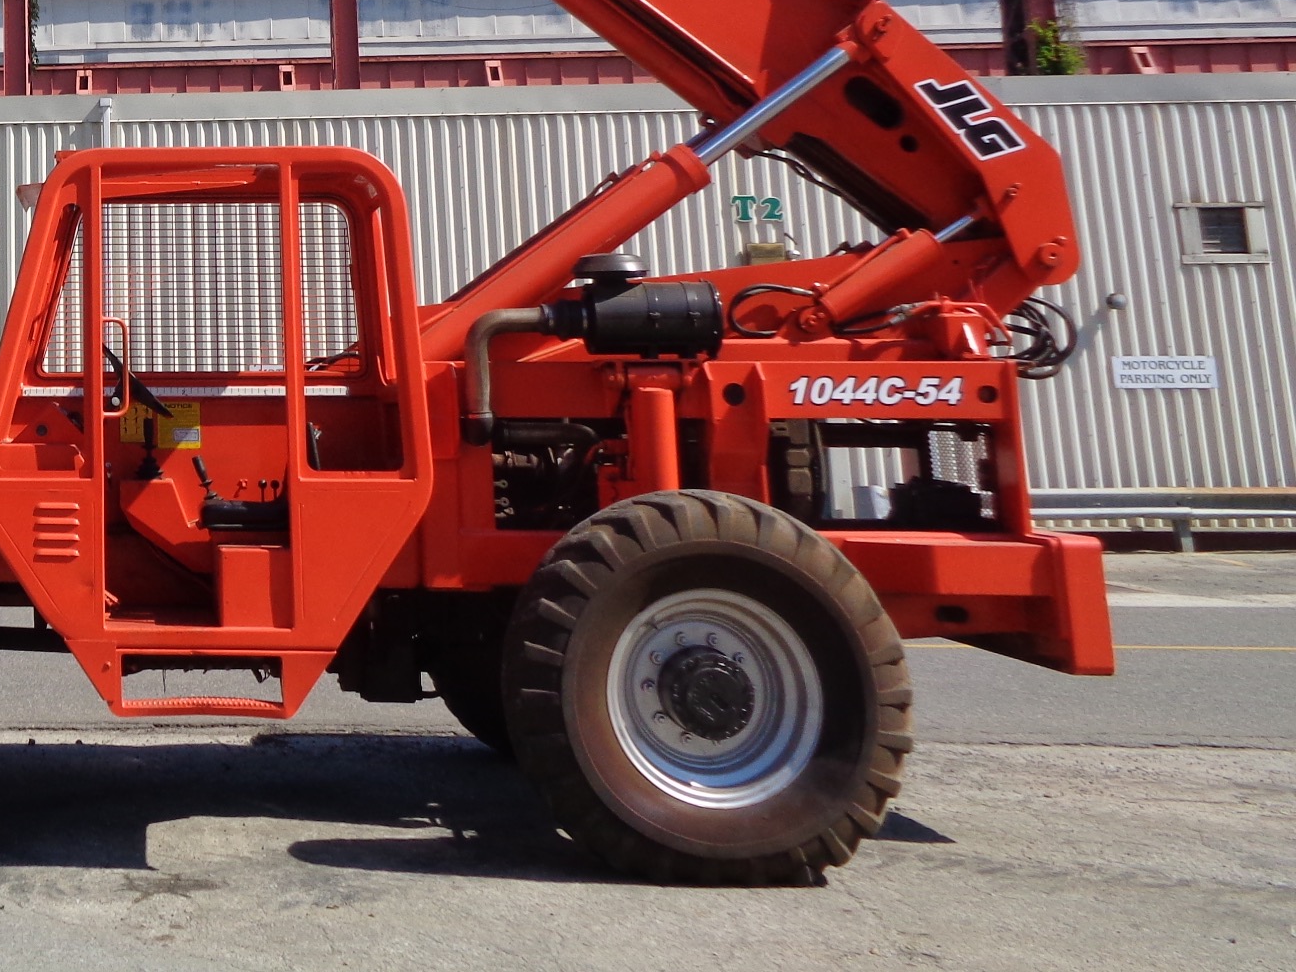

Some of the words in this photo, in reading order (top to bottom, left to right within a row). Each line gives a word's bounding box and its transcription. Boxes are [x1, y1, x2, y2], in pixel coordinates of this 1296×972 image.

[913, 78, 1026, 161] JLG
[1120, 360, 1206, 371] MOTORCYCLE
[1119, 374, 1175, 384] PARKING
[1180, 374, 1211, 384] ONLY
[788, 375, 963, 406] 1044C-54
